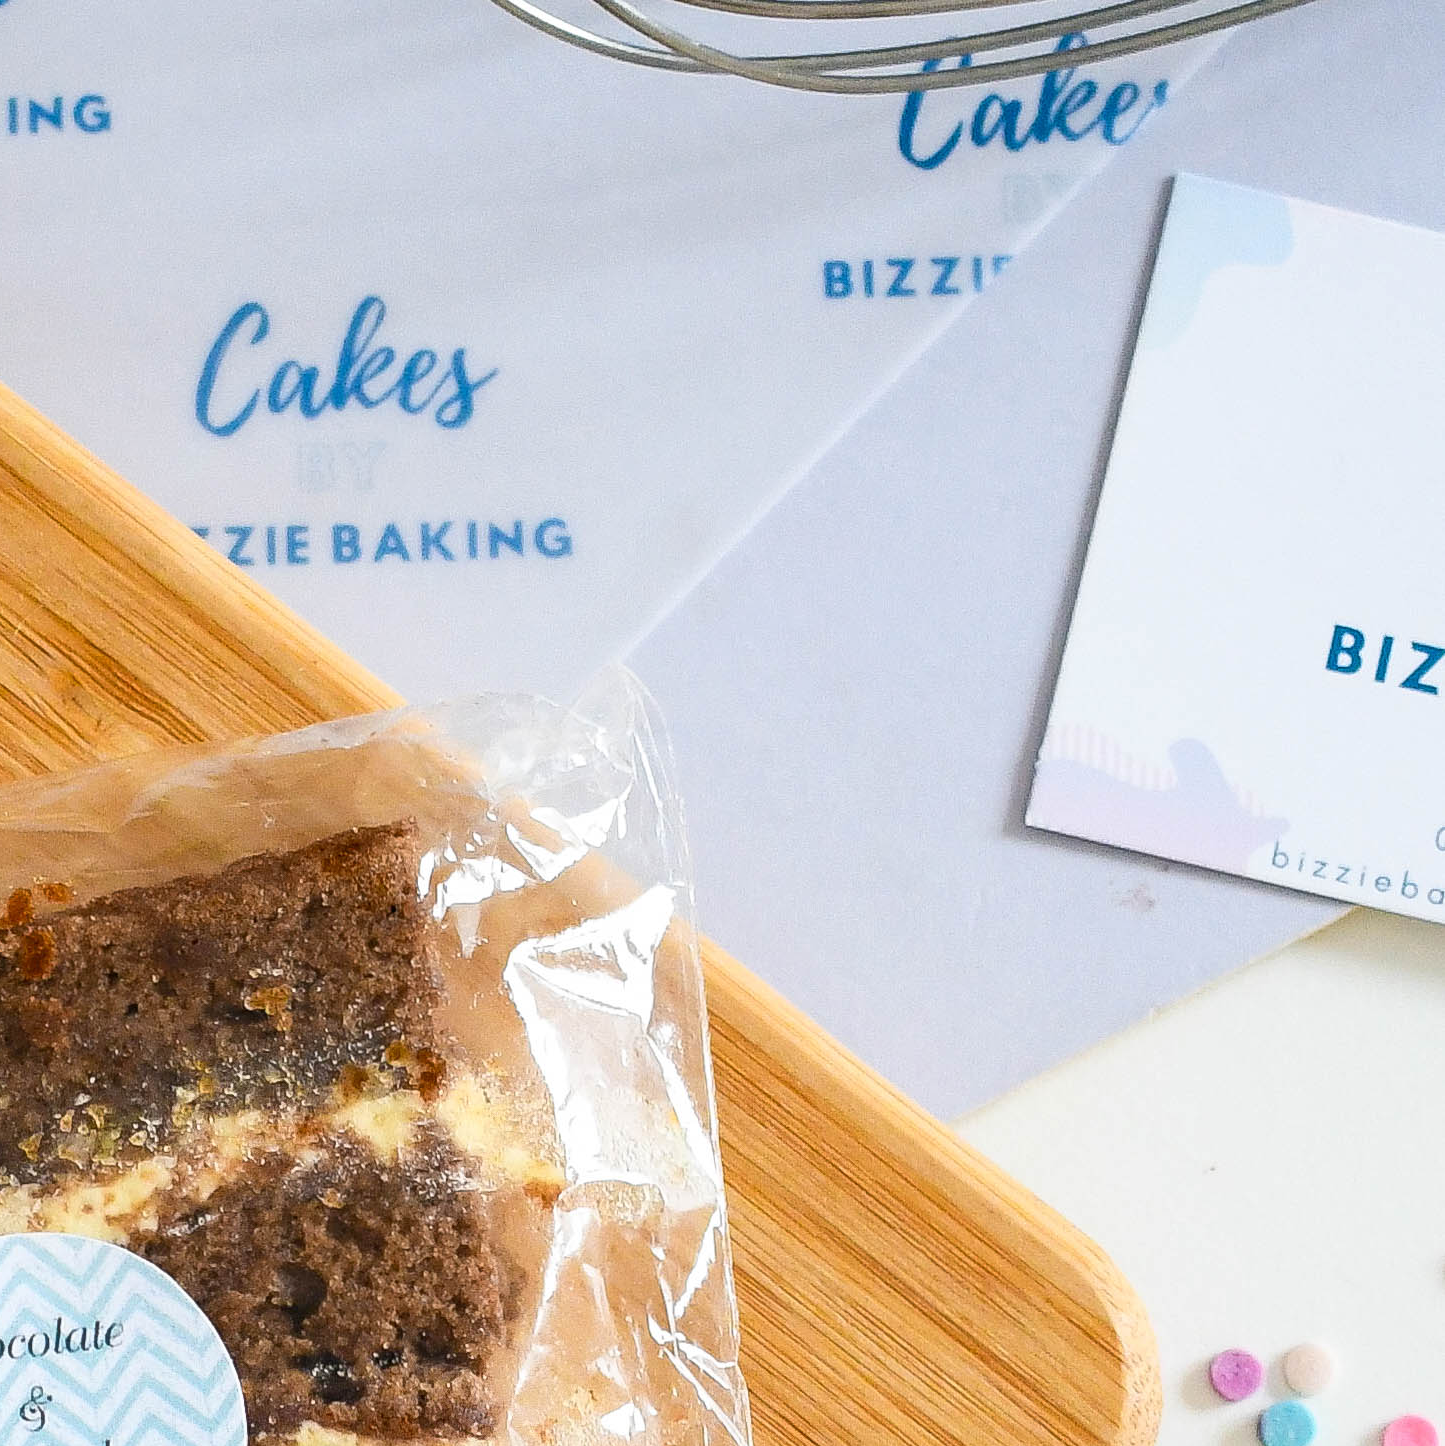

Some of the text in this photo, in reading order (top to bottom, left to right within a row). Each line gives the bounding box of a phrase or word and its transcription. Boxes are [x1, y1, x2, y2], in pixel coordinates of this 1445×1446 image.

[898, 31, 1169, 170] Cake
[194, 296, 499, 437] Cakes
[331, 517, 573, 563] BAKING
[1325, 624, 1445, 696] BIZ
[1271, 840, 1445, 905] bizzieba
[18, 1385, 53, 1432] &
